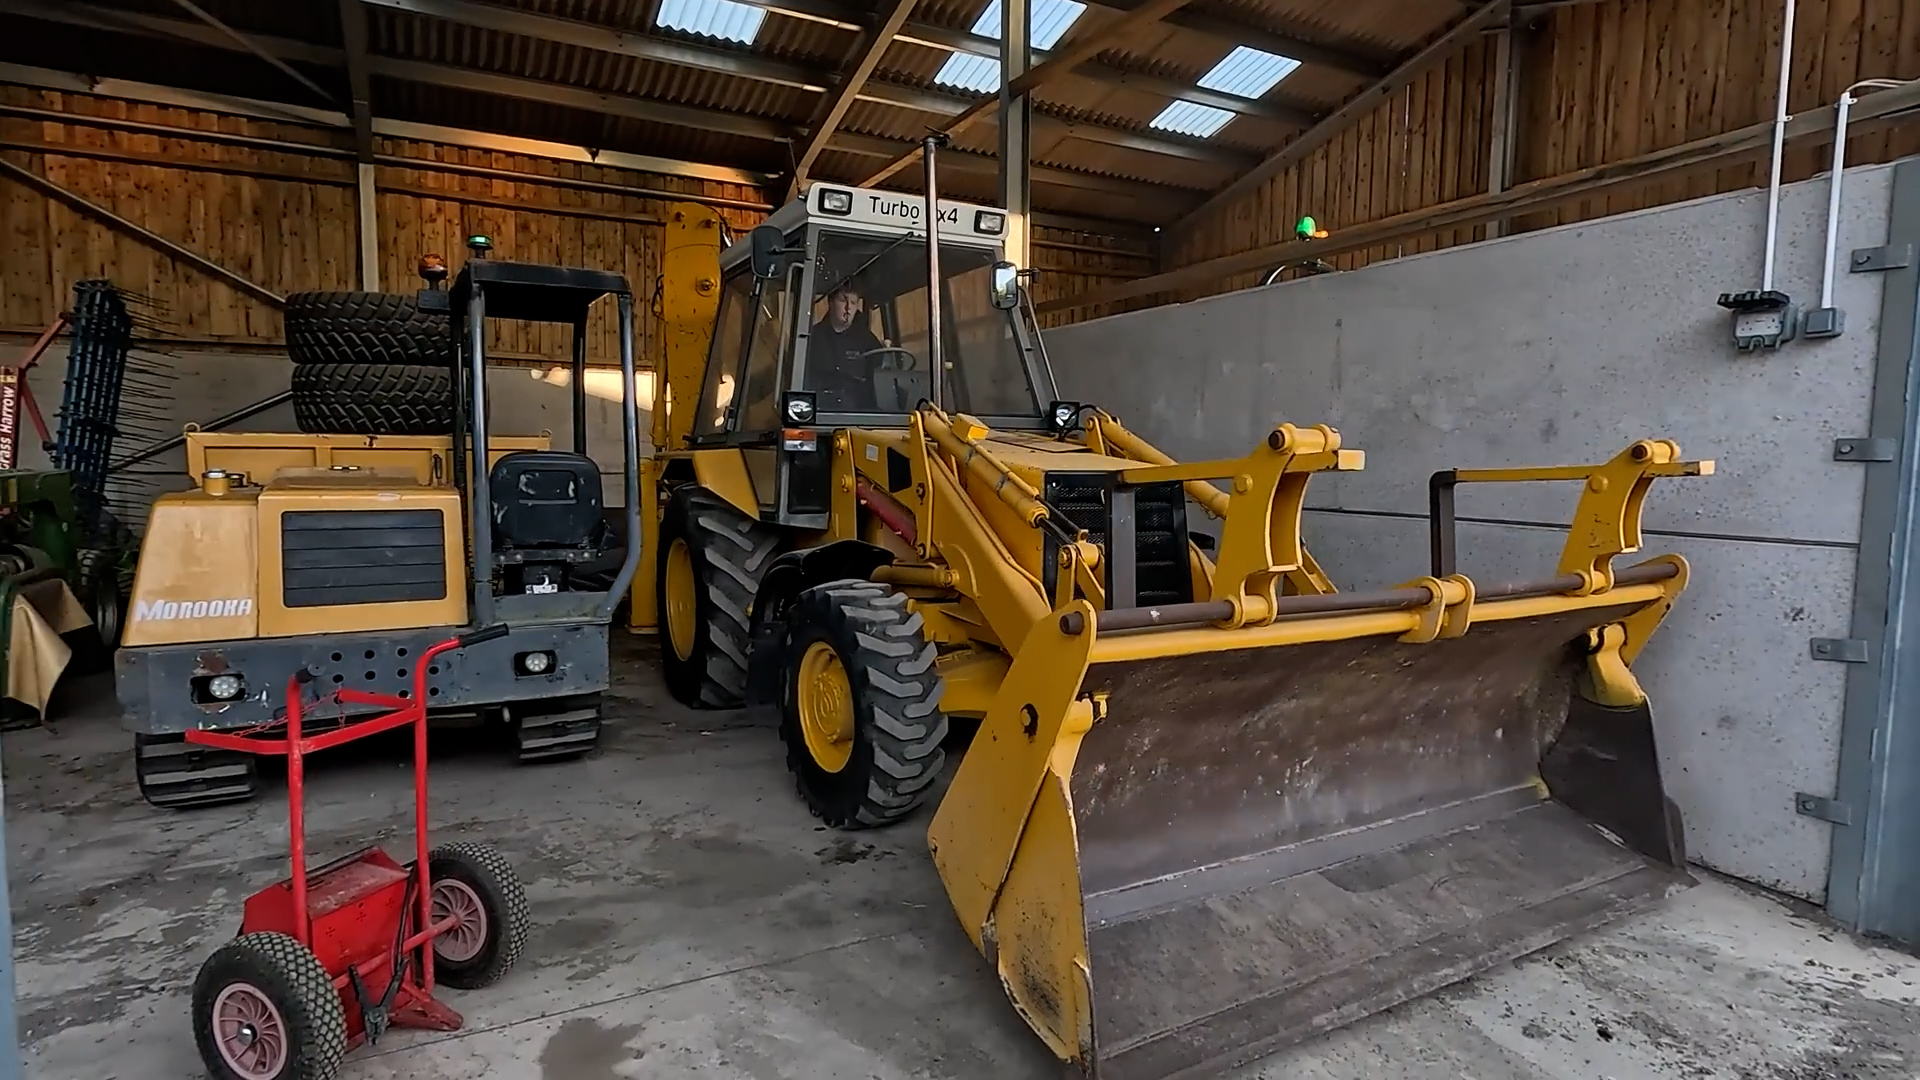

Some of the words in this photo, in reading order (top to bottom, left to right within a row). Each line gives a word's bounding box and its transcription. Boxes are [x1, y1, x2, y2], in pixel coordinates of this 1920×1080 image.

[868, 195, 920, 220] Turbo
[936, 207, 958, 225] x4
[0, 386, 15, 434] Harrow
[134, 599, 252, 621] MOROOKA
